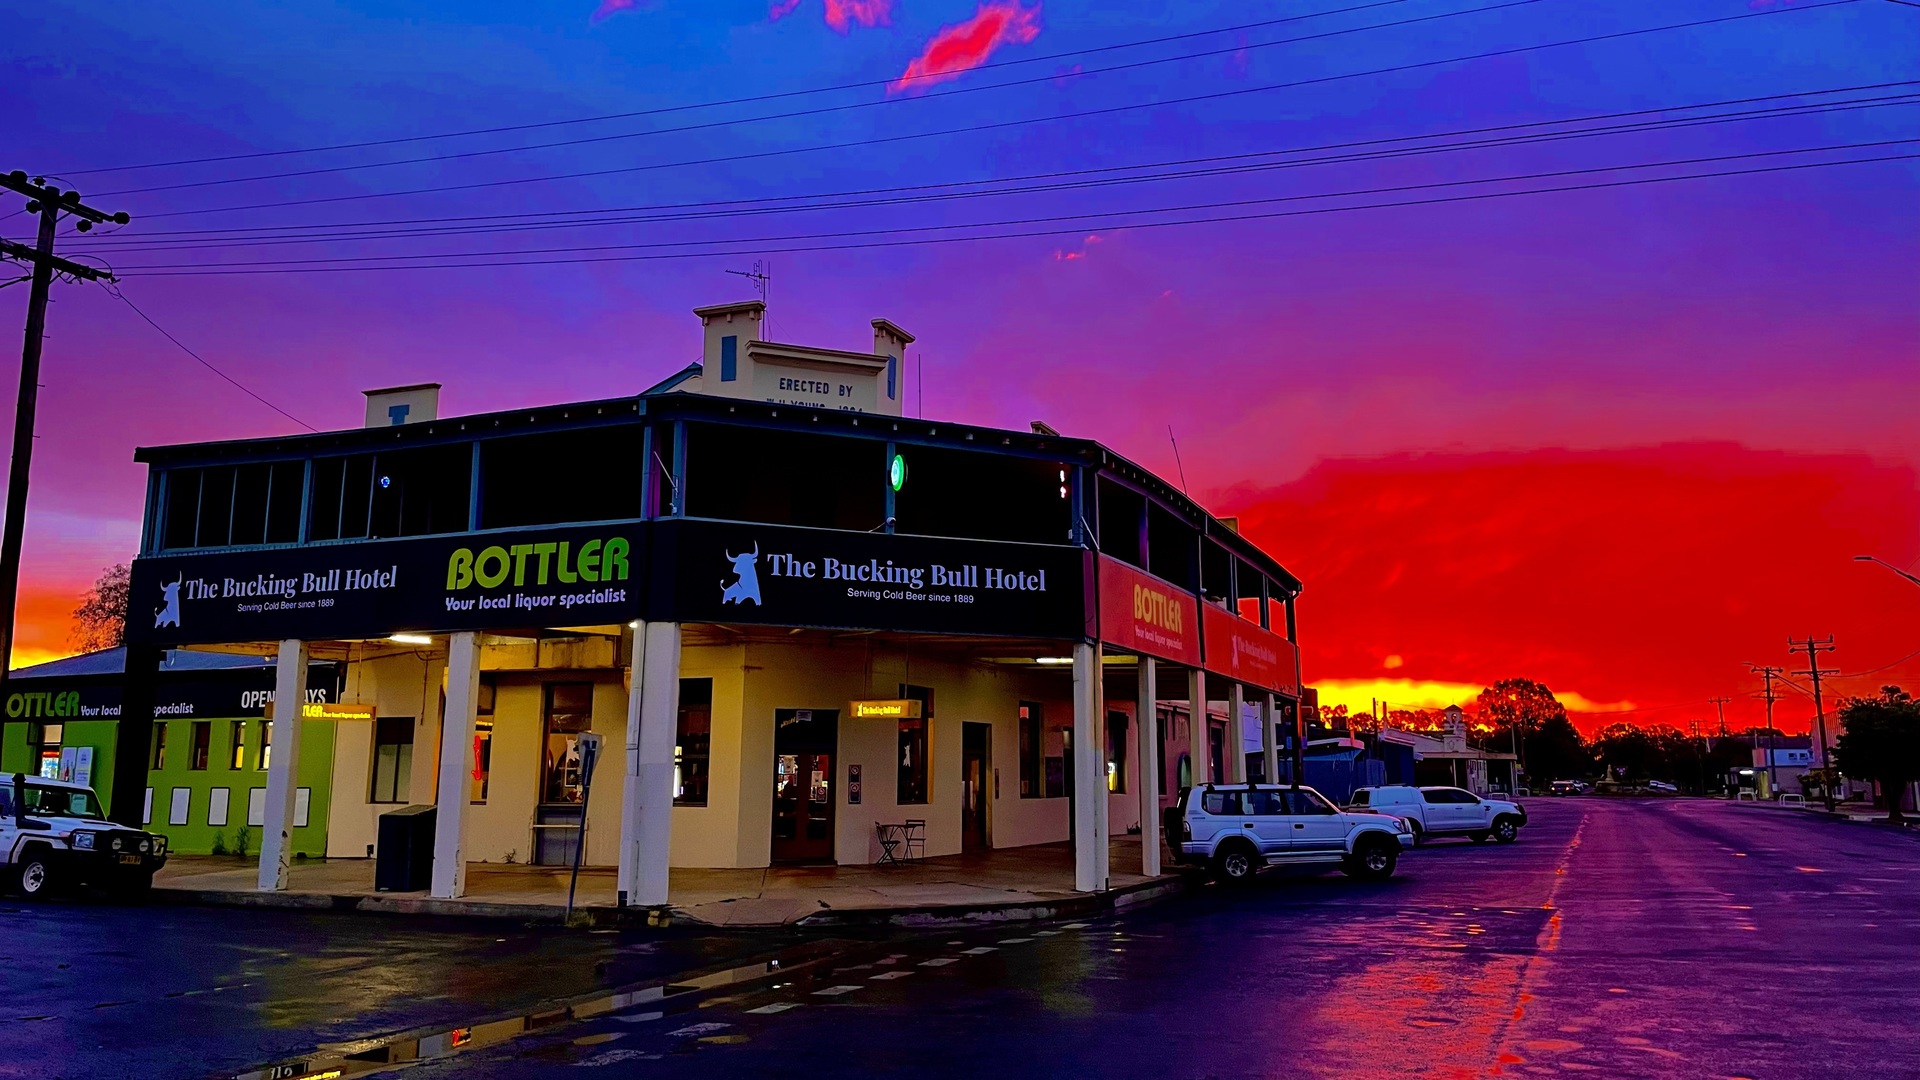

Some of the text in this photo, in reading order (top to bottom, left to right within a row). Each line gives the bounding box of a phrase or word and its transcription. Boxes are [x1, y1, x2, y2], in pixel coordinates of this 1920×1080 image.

[779, 377, 853, 397] ERECTED BY
[446, 537, 630, 590] BOTTLER
[767, 553, 1047, 592] The Bucking Bull Hotel
[185, 565, 397, 600] The Bucking Bull Hotel
[237, 598, 335, 613] Serving Cold Beer since 1889
[445, 588, 626, 611] Your local liquor specialist
[847, 588, 974, 604] Serving Cold Beer since 1889
[1133, 583, 1182, 635] BOTTLER
[6, 690, 80, 718] OTTLER
[80, 705, 100, 716] Your
[101, 704, 121, 716] local
[241, 690, 276, 708] OPEN
[302, 705, 323, 717] TLER
